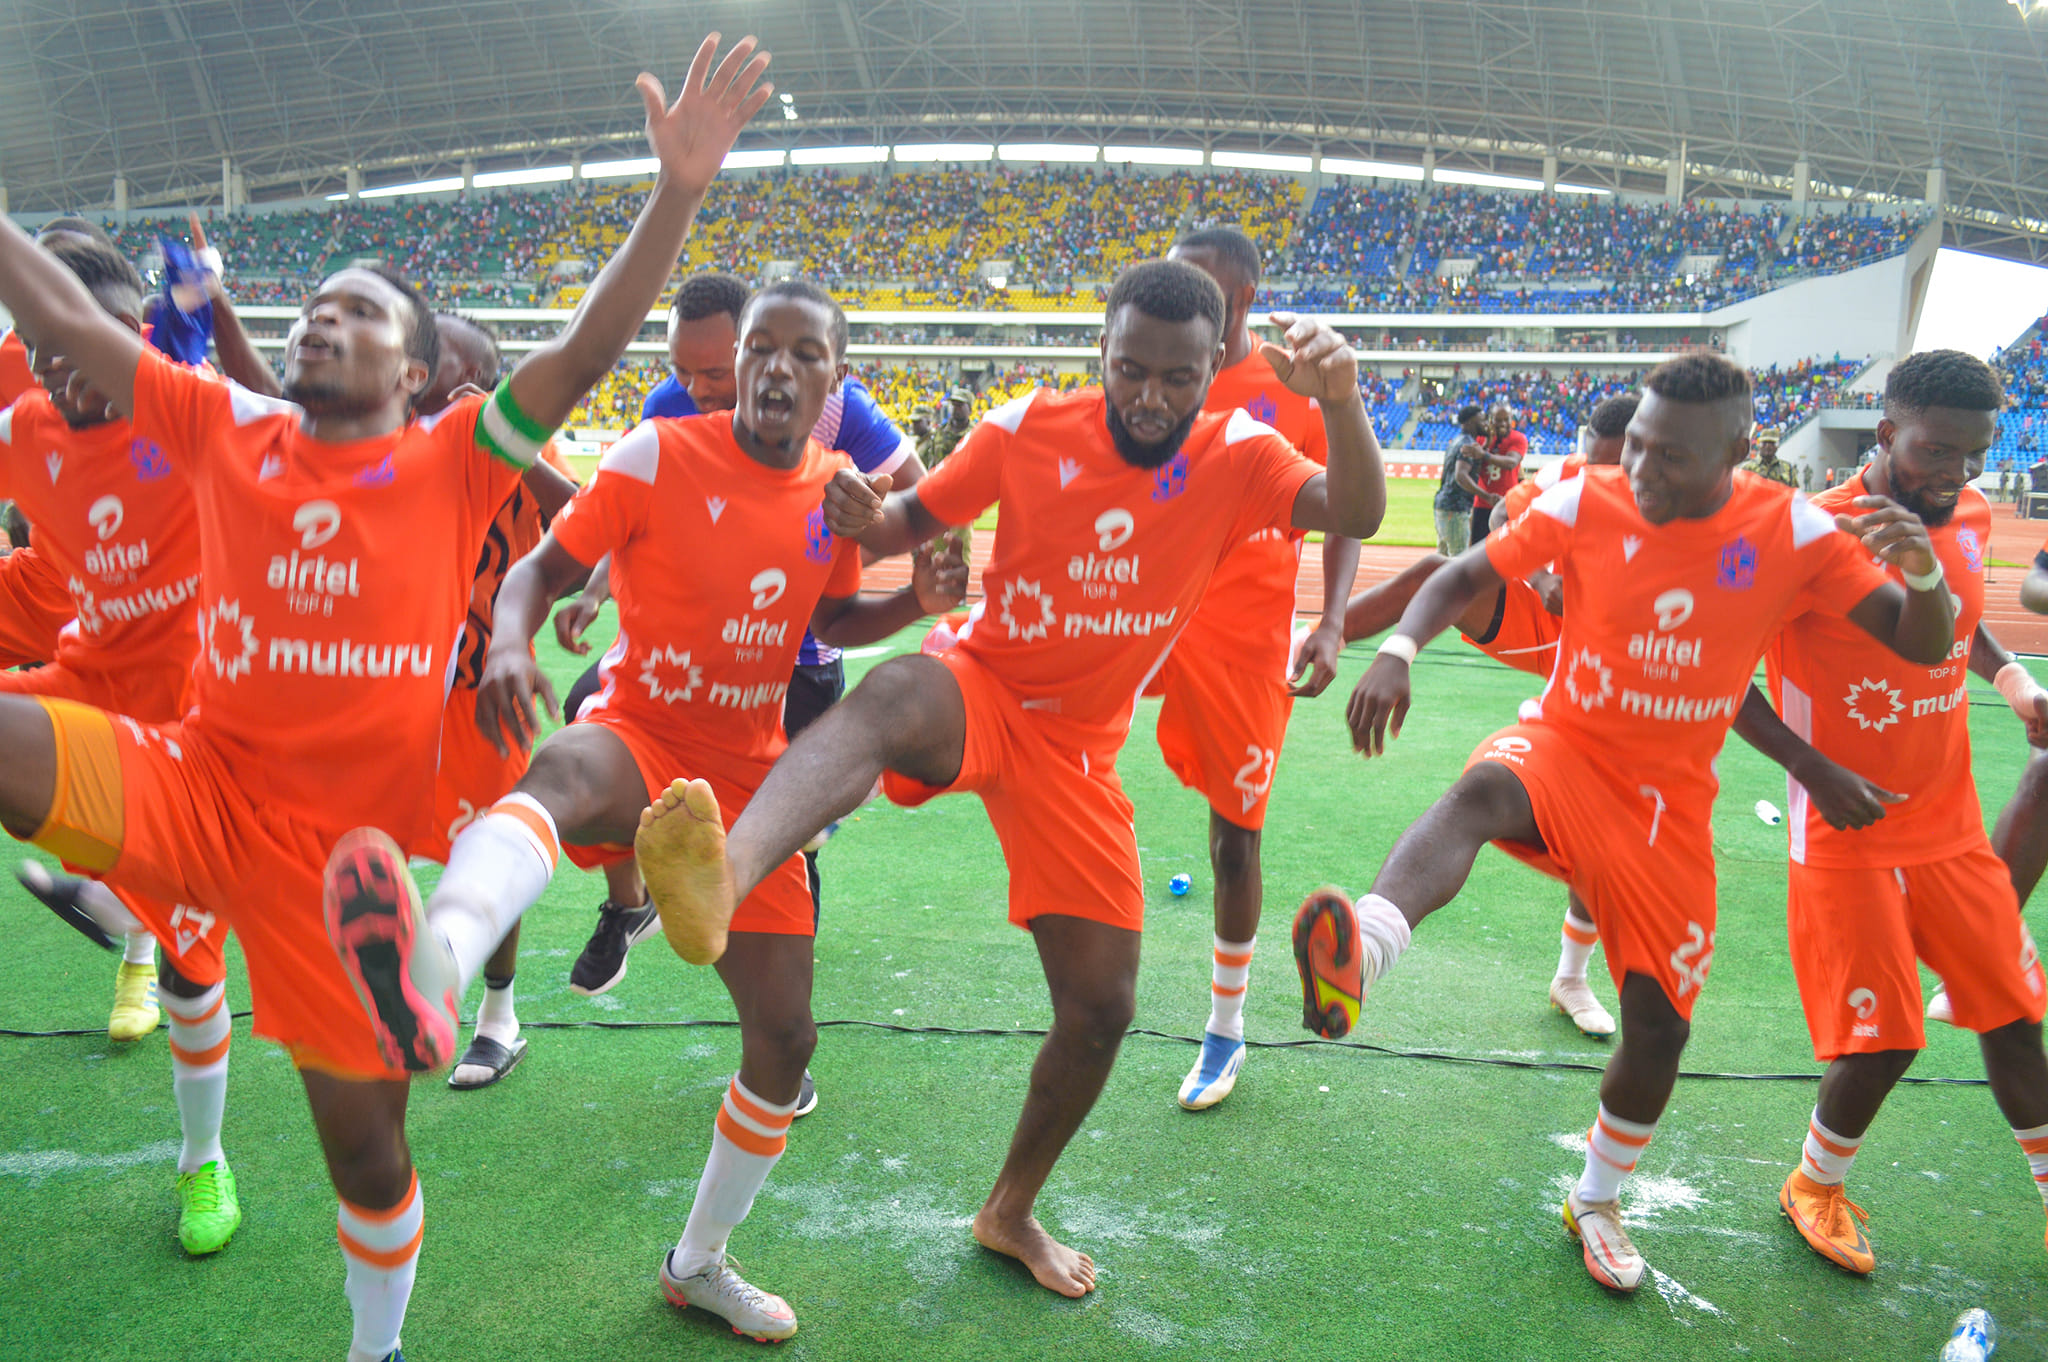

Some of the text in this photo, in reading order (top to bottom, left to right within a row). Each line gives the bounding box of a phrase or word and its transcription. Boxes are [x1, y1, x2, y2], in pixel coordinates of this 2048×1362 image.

[84, 538, 149, 575] airtel
[267, 549, 360, 597] airtel
[1067, 552, 1139, 585] airtel
[100, 572, 202, 622] mukur
[287, 589, 320, 616] TOP
[1082, 580, 1117, 601] TOP 8
[722, 613, 788, 647] airtel
[1064, 606, 1177, 639] mukuru
[268, 636, 433, 678] mukuru
[735, 647, 755, 664] TOP
[1627, 629, 1702, 668] airtel
[1643, 661, 1679, 682] TOP 8
[1928, 666, 1958, 680] TOP 8
[1620, 688, 1738, 722] mukuru
[1233, 744, 1275, 796] 23
[1484, 750, 1524, 767] airtel
[447, 797, 492, 842] 2
[1852, 1022, 1879, 1038] airtel
